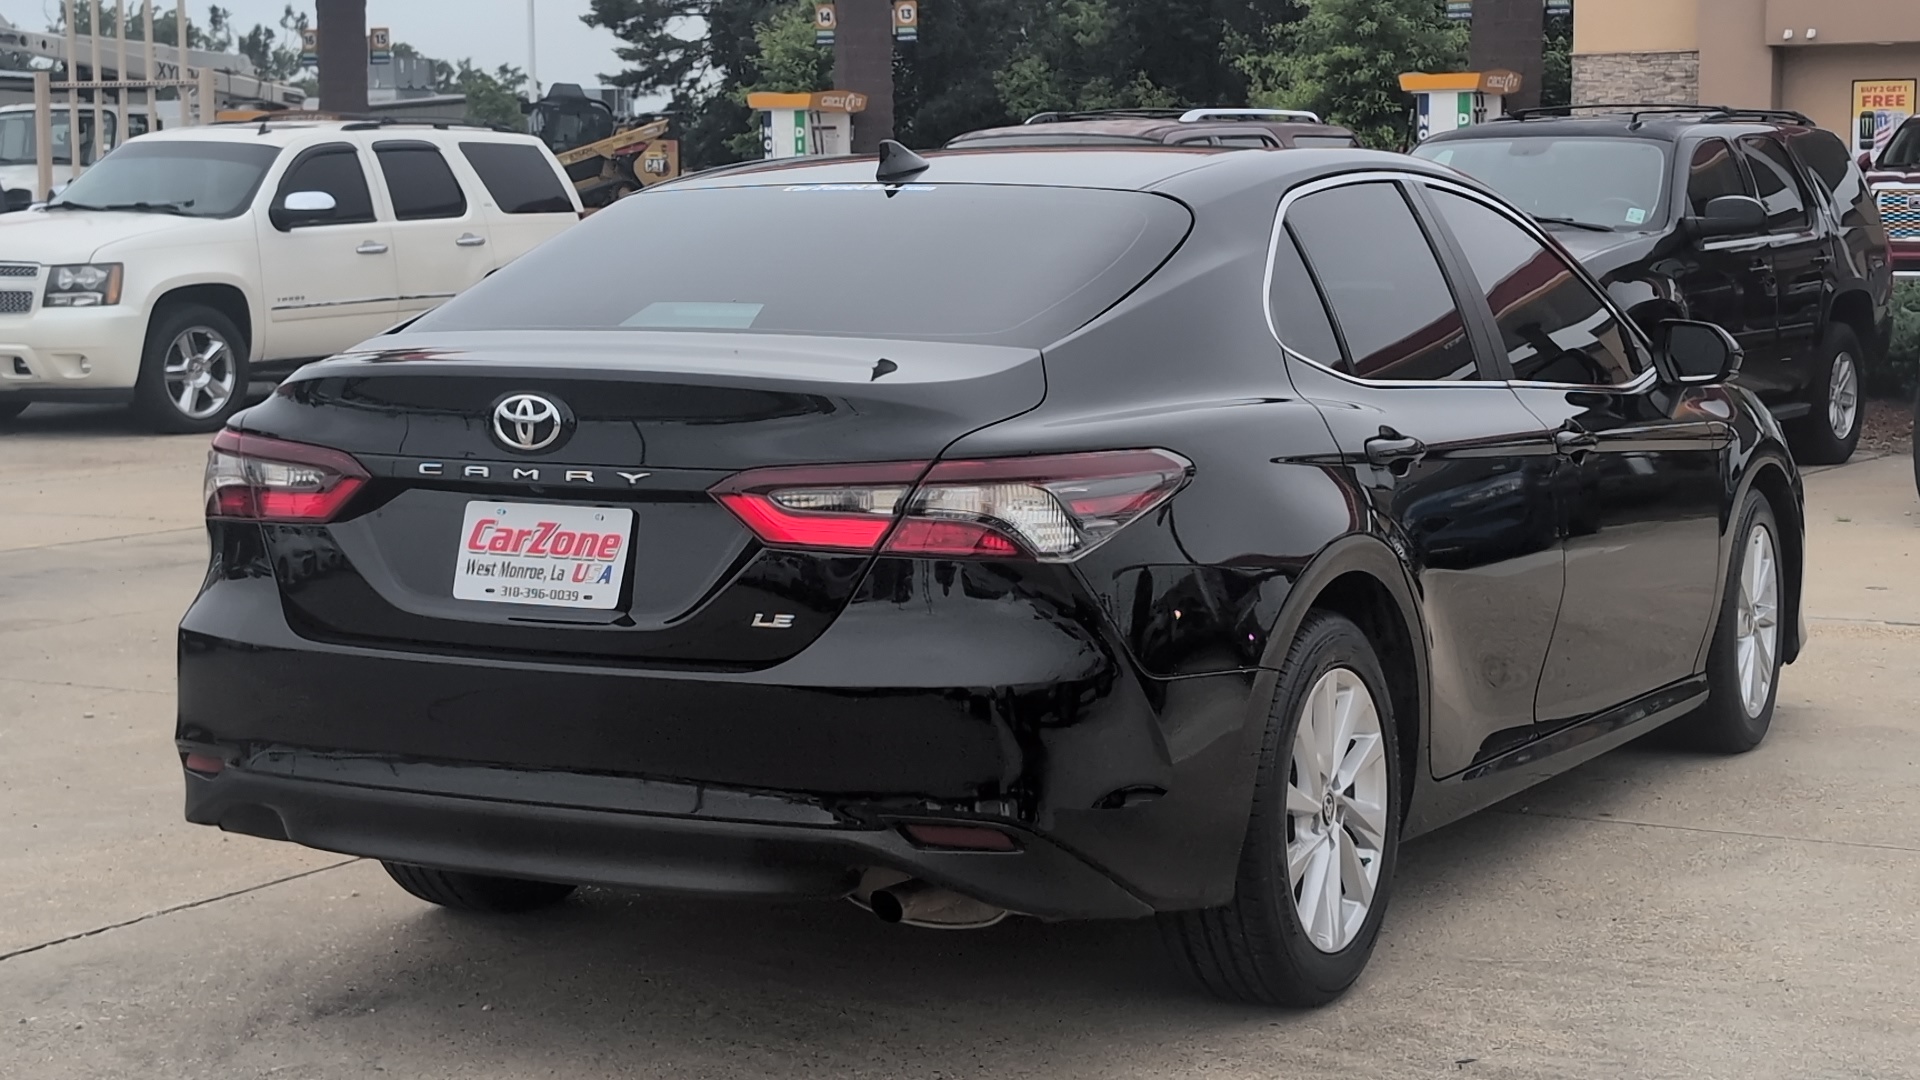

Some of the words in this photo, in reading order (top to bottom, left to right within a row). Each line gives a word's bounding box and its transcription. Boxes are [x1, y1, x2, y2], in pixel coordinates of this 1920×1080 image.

[820, 12, 831, 22] 14
[901, 9, 911, 19] 13
[375, 34, 387, 44] 15
[1861, 94, 1905, 107] FREE
[795, 127, 805, 157] DI
[644, 159, 666, 173] CAT
[418, 462, 651, 485] CAMRY
[467, 518, 623, 561] CarZone
[465, 558, 497, 577] West
[498, 561, 549, 583] Monroe,
[550, 563, 566, 582] La
[571, 562, 613, 585] USA
[751, 612, 796, 629] LE
